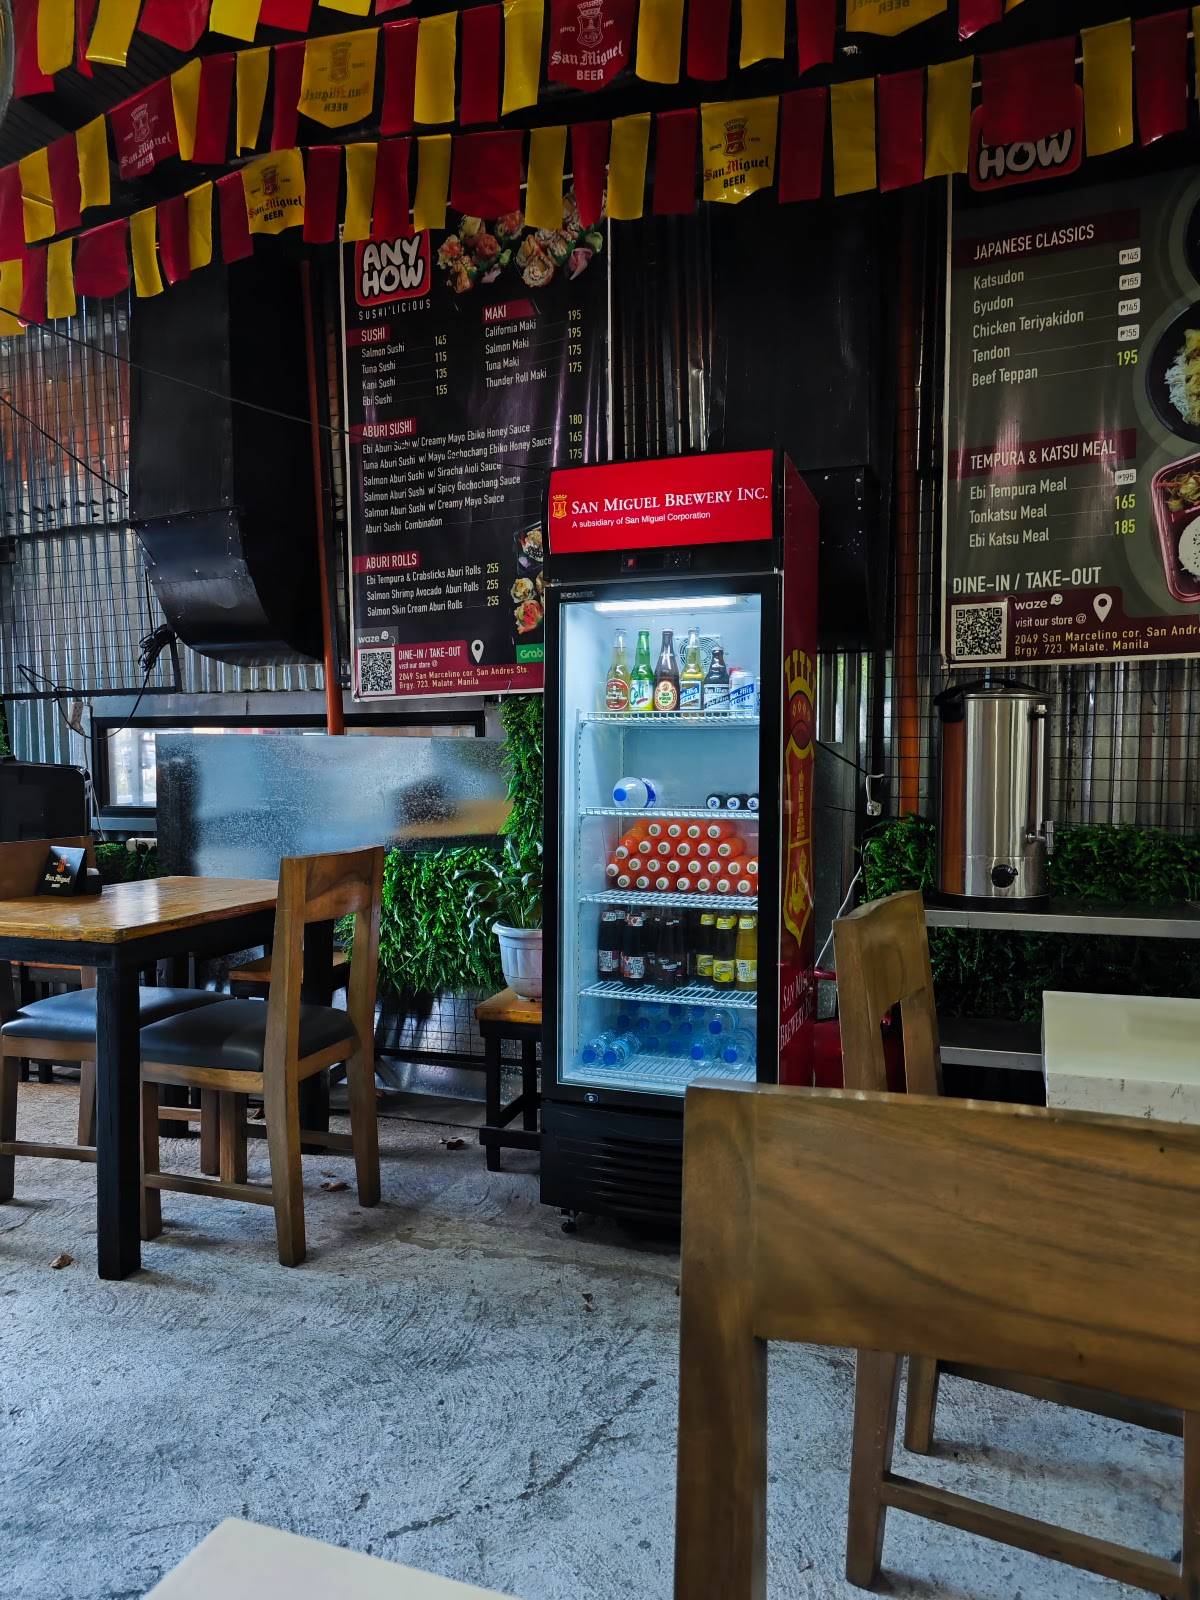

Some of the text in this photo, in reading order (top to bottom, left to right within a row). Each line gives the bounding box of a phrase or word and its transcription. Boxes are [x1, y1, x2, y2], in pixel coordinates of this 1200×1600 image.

[550, 40, 624, 66] San Miguel
[576, 68, 604, 81] BEER
[979, 128, 1072, 180] HOW
[704, 156, 771, 181] San Miguel
[723, 175, 746, 188] BEER
[265, 196, 304, 210] Miguel
[263, 210, 284, 221] BEER
[974, 223, 1095, 260] JAPANESE CLASSICS
[363, 235, 421, 272] ANY
[362, 258, 424, 298] HOW
[974, 269, 1025, 290] Katsudon
[485, 305, 507, 320] MAKI
[973, 296, 1014, 316] Gyudon
[361, 327, 386, 343] SUSHI
[485, 309, 582, 338] California Maki 195
[972, 310, 1085, 339] Chicken Teriyakidon
[362, 335, 447, 359] Salmon Sushi 145
[485, 327, 582, 355] Salmon Maki 195
[362, 352, 447, 375] Tuna Sushi 115
[485, 344, 582, 372] Tuna Maki 175
[972, 345, 1011, 363] Tendon
[1117, 349, 1139, 366] 195
[379, 368, 448, 388] Sushi 135
[485, 361, 582, 388] Thunder Roll Maki 175
[972, 367, 1038, 387] Beef Teppan
[362, 384, 448, 407] Ebi Sushi 155
[362, 420, 412, 438] ABURI SUSHI
[363, 413, 583, 455] Ebi Creamy Mayo Honey Sauce 180
[363, 431, 583, 471] Tuna Sushi Ebiko Honey Sauce 165
[971, 439, 1116, 470] TEMPURA & KATSU MEAL
[363, 448, 583, 486] Salmon Sushi Siracha Aioli Sauce 175
[364, 474, 521, 502] Salmon Sushi Spicy Sauce
[970, 476, 1068, 502] Ebi Tempura Meal
[364, 493, 505, 518] Salmon Sushi Creamy Mayo Sauce
[571, 486, 769, 515] SAN MIGUEL BREWERY INC.
[969, 494, 1137, 524] Tonkatsu Meal 165
[365, 517, 443, 534] Aburi Sushi Combination
[579, 518, 615, 530] subsidiary
[616, 517, 624, 525] of
[624, 515, 640, 524] San
[641, 513, 666, 525] Miguel
[667, 511, 711, 524] Corporation
[969, 519, 1136, 548] Ebi Katsu Meal 185
[366, 553, 417, 570] ABURI ROLLS
[377, 562, 499, 586] Tempura Crabsticks Aburi Rolls 255
[952, 566, 1102, 594] DINE-IN / TAKE-OUT
[366, 579, 499, 602] Salmon Shrimp Avocado Aburi Rolls 255
[367, 596, 500, 617] Salmon Skin Cream Aburi Rolls 255
[1014, 600, 1048, 610] waze
[1015, 613, 1087, 628] visit our store @
[1014, 626, 1167, 645] 2049 San Marcelino San
[1112, 640, 1149, 650] Manila
[429, 646, 462, 658] TAKE-OUT
[429, 666, 515, 678] Marcelino San Andres
[457, 678, 479, 686] Manila
